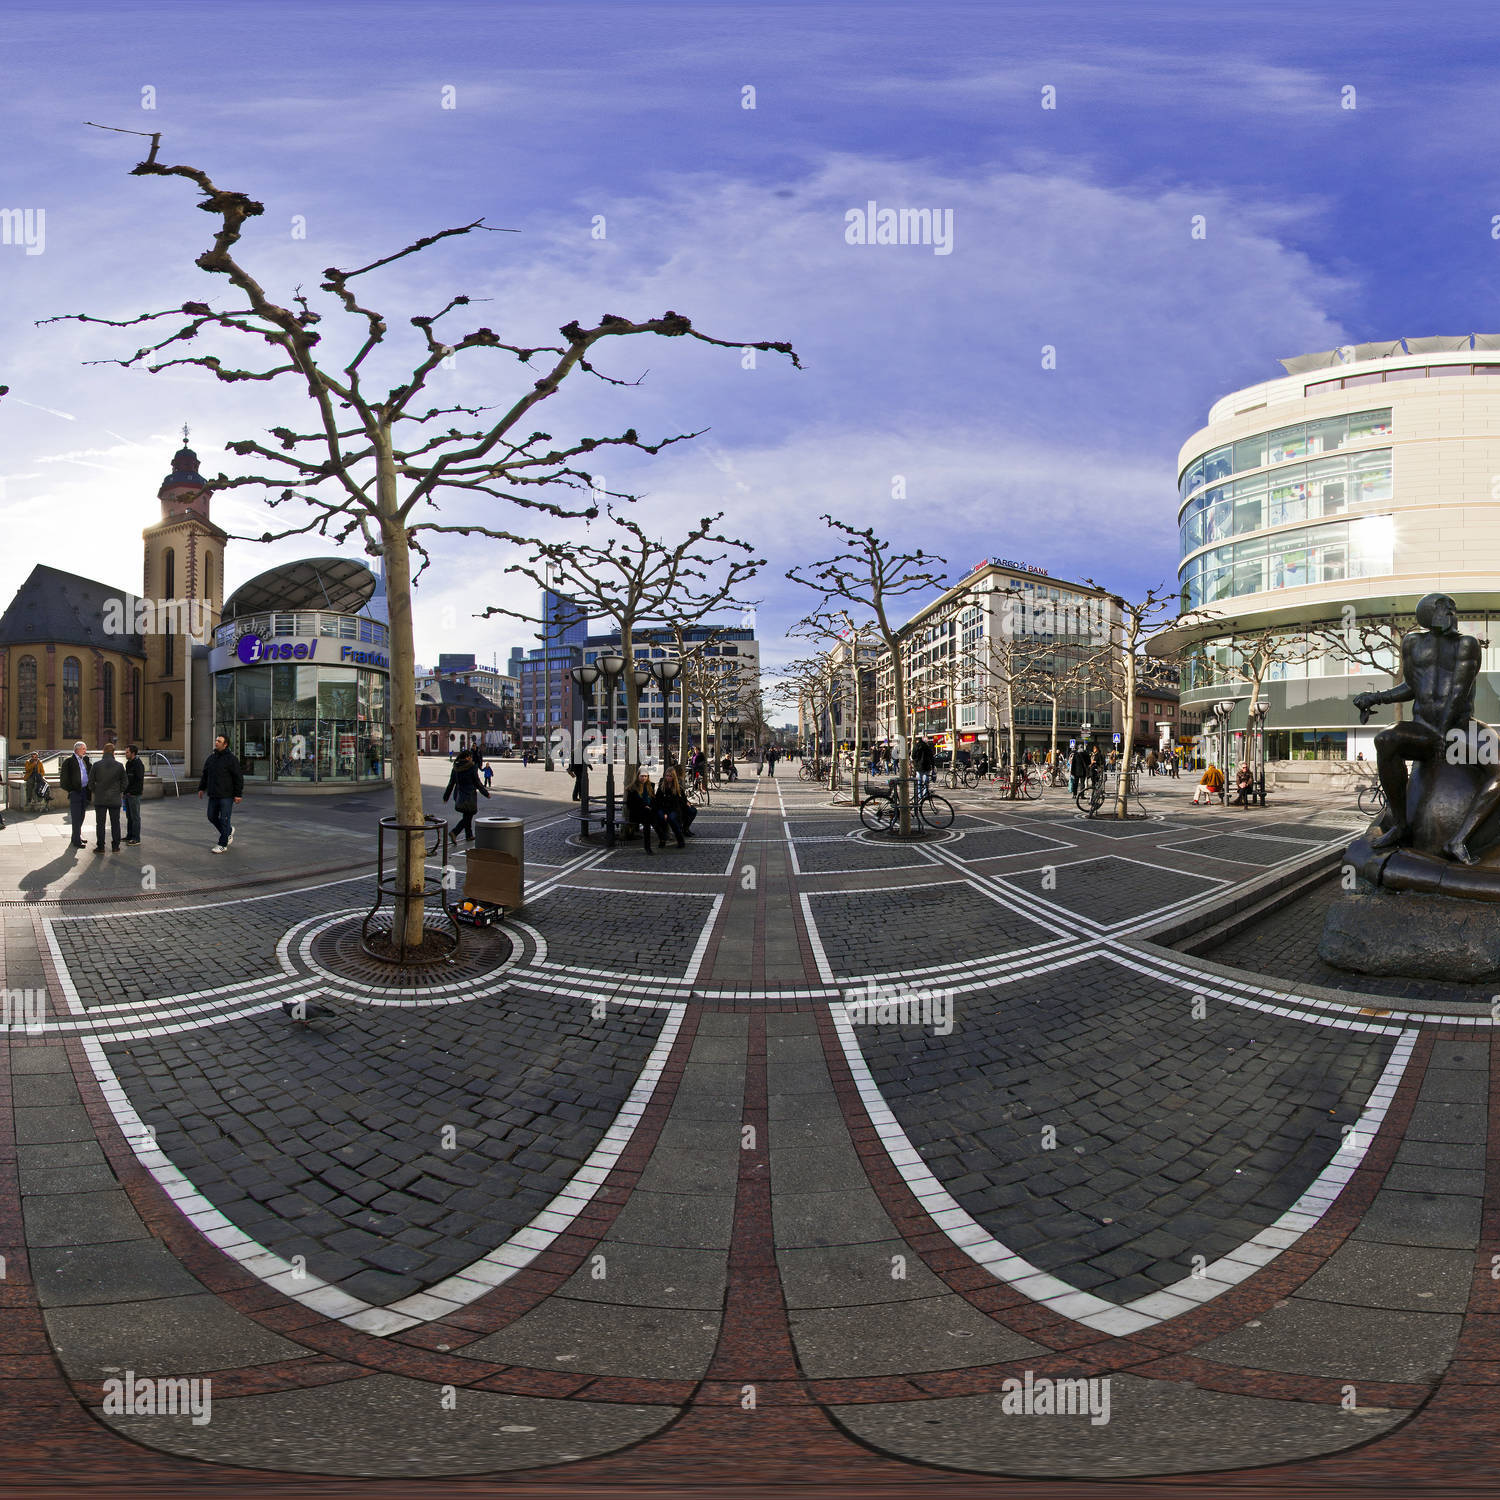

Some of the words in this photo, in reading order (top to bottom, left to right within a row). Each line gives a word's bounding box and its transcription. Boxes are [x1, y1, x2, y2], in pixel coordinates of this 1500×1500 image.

[992, 557, 1020, 569] TARGO
[1028, 565, 1049, 577] BANK
[249, 638, 318, 661] insel
